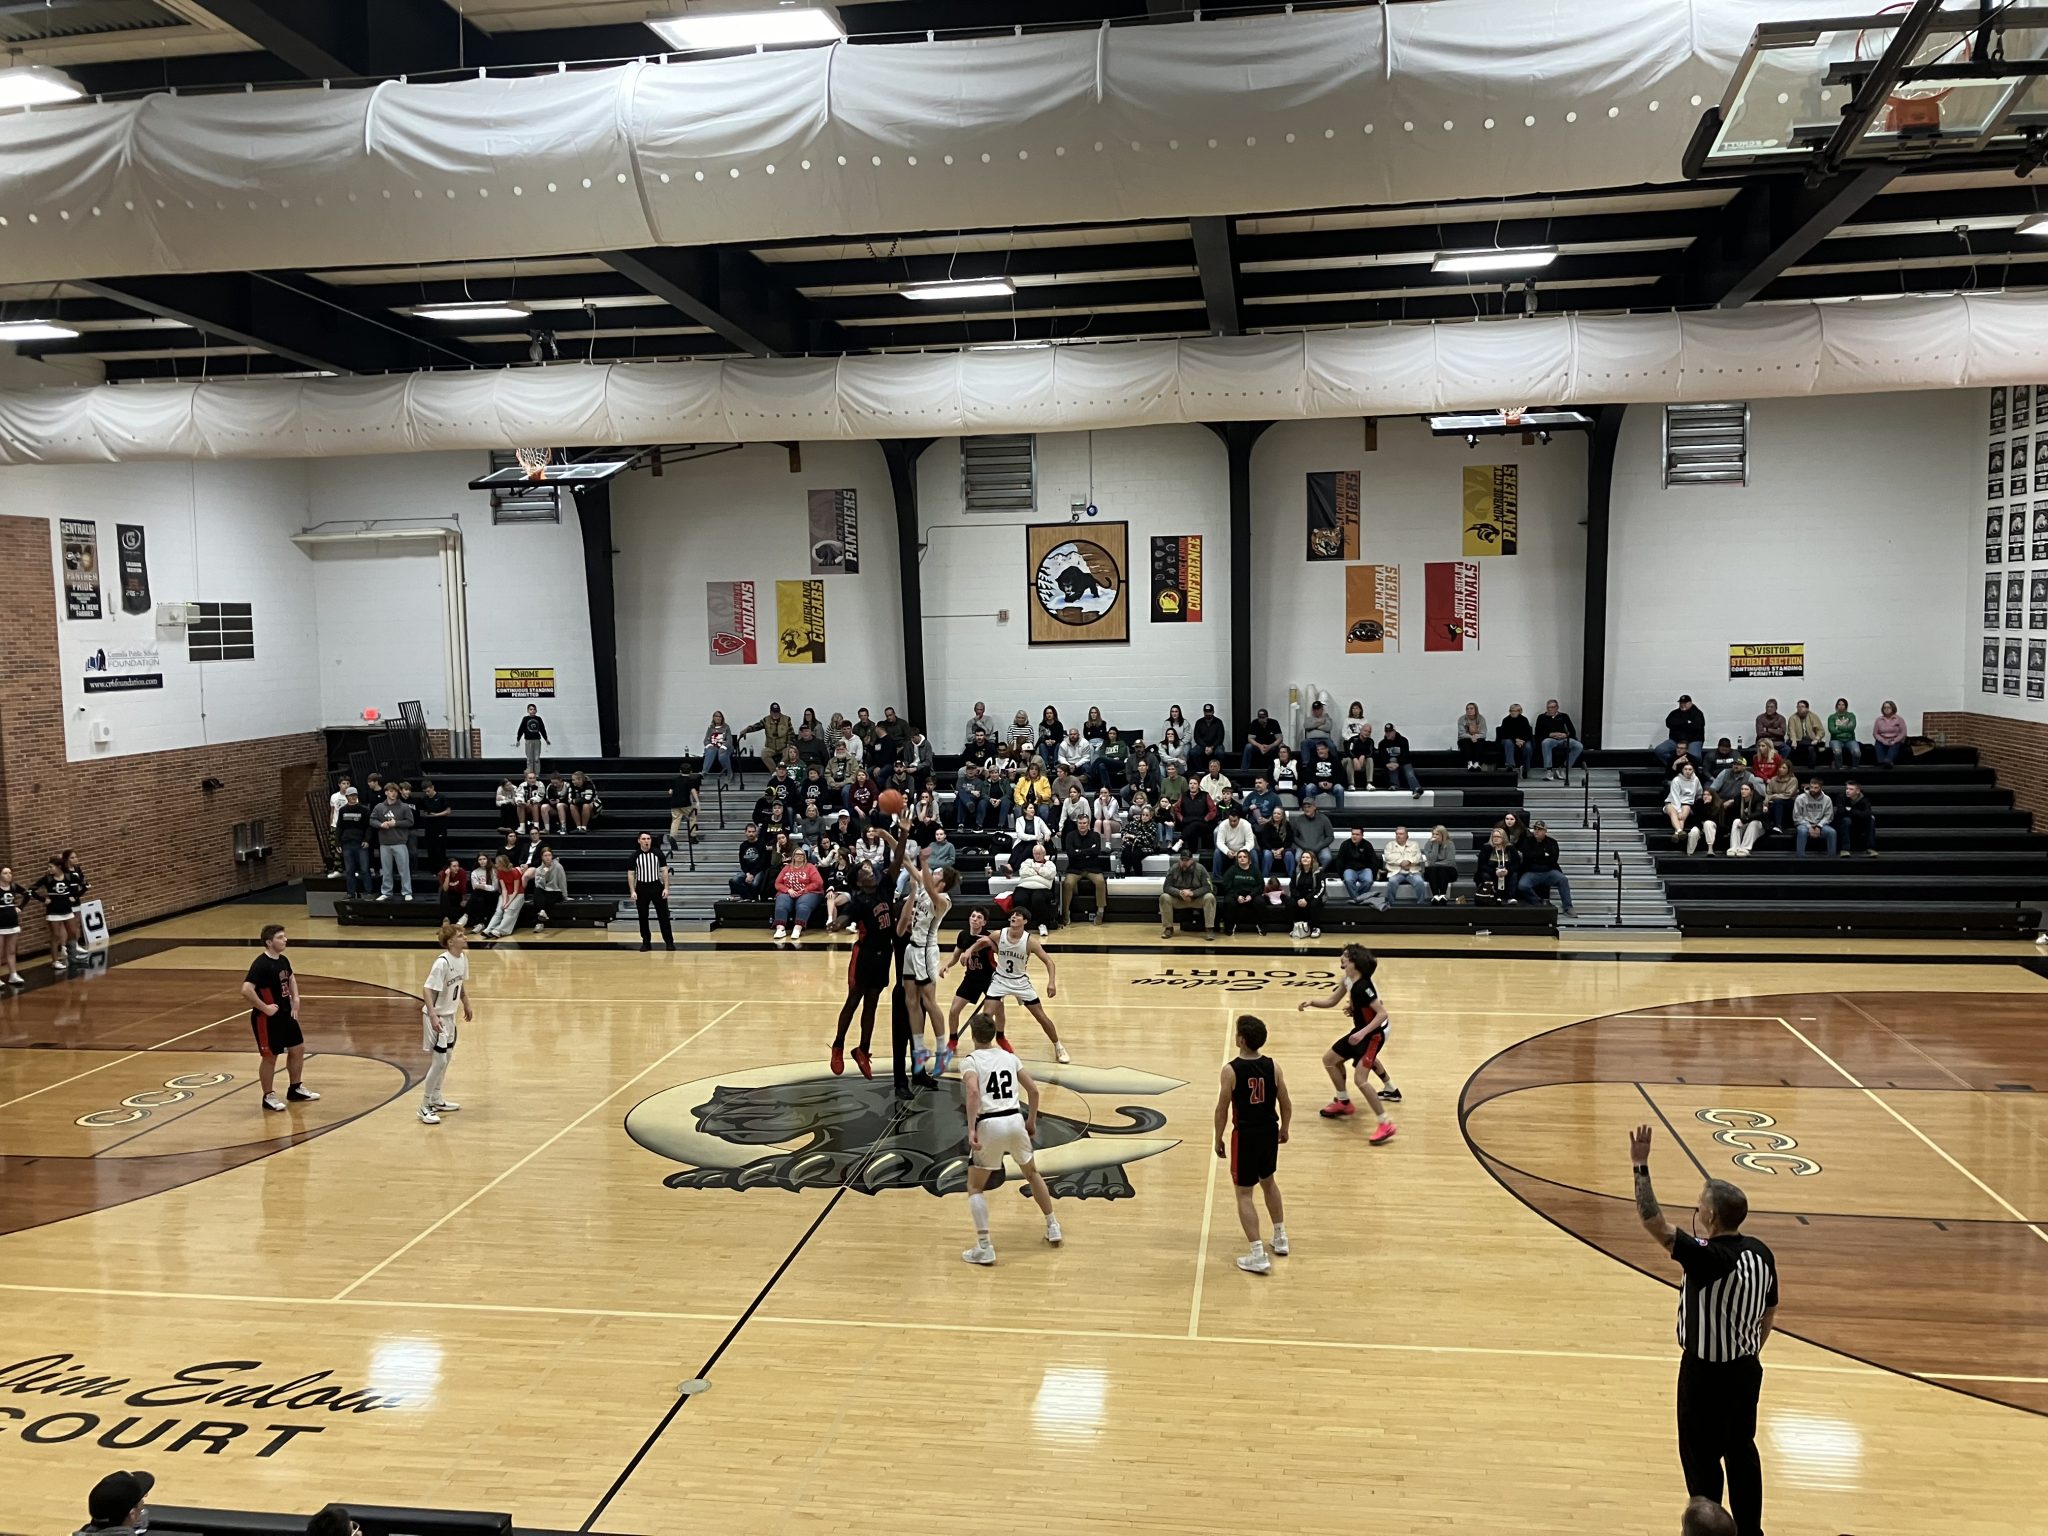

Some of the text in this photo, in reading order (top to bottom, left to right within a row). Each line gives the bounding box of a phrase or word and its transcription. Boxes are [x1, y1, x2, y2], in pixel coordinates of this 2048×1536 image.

[1345, 473, 1358, 525] TIGERS
[1493, 467, 1503, 522] MONROE CITY
[1503, 466, 1516, 542] PANTHERS
[61, 521, 95, 535] CENTRALIA
[843, 490, 857, 562] PANTHERS
[72, 582, 94, 591] PRIDE
[1178, 561, 1188, 590] CLARENCE
[1187, 536, 1200, 611] CONFERENCE
[1375, 565, 1384, 610] PALMYRA
[1454, 563, 1463, 618] SOUTH SHELBY
[742, 582, 755, 640] INDIANS
[802, 581, 812, 624] HIGHLAND
[811, 581, 824, 643] COUGARS
[1385, 566, 1397, 640] PANTHERS
[1464, 563, 1477, 639] CARDINALS
[108, 658, 160, 668] FOUNDATION
[1731, 656, 1803, 666] STUDENT SECTION
[1756, 646, 1790, 655] VISITOR
[496, 680, 553, 688] STUDENT SECTION
[1005, 960, 1014, 974] 3
[1155, 969, 1336, 979] COURT
[74, 1073, 234, 1127] CCC
[986, 1070, 1013, 1100] 42
[1247, 1077, 1265, 1104] 21
[1695, 1108, 1822, 1176] CCC
